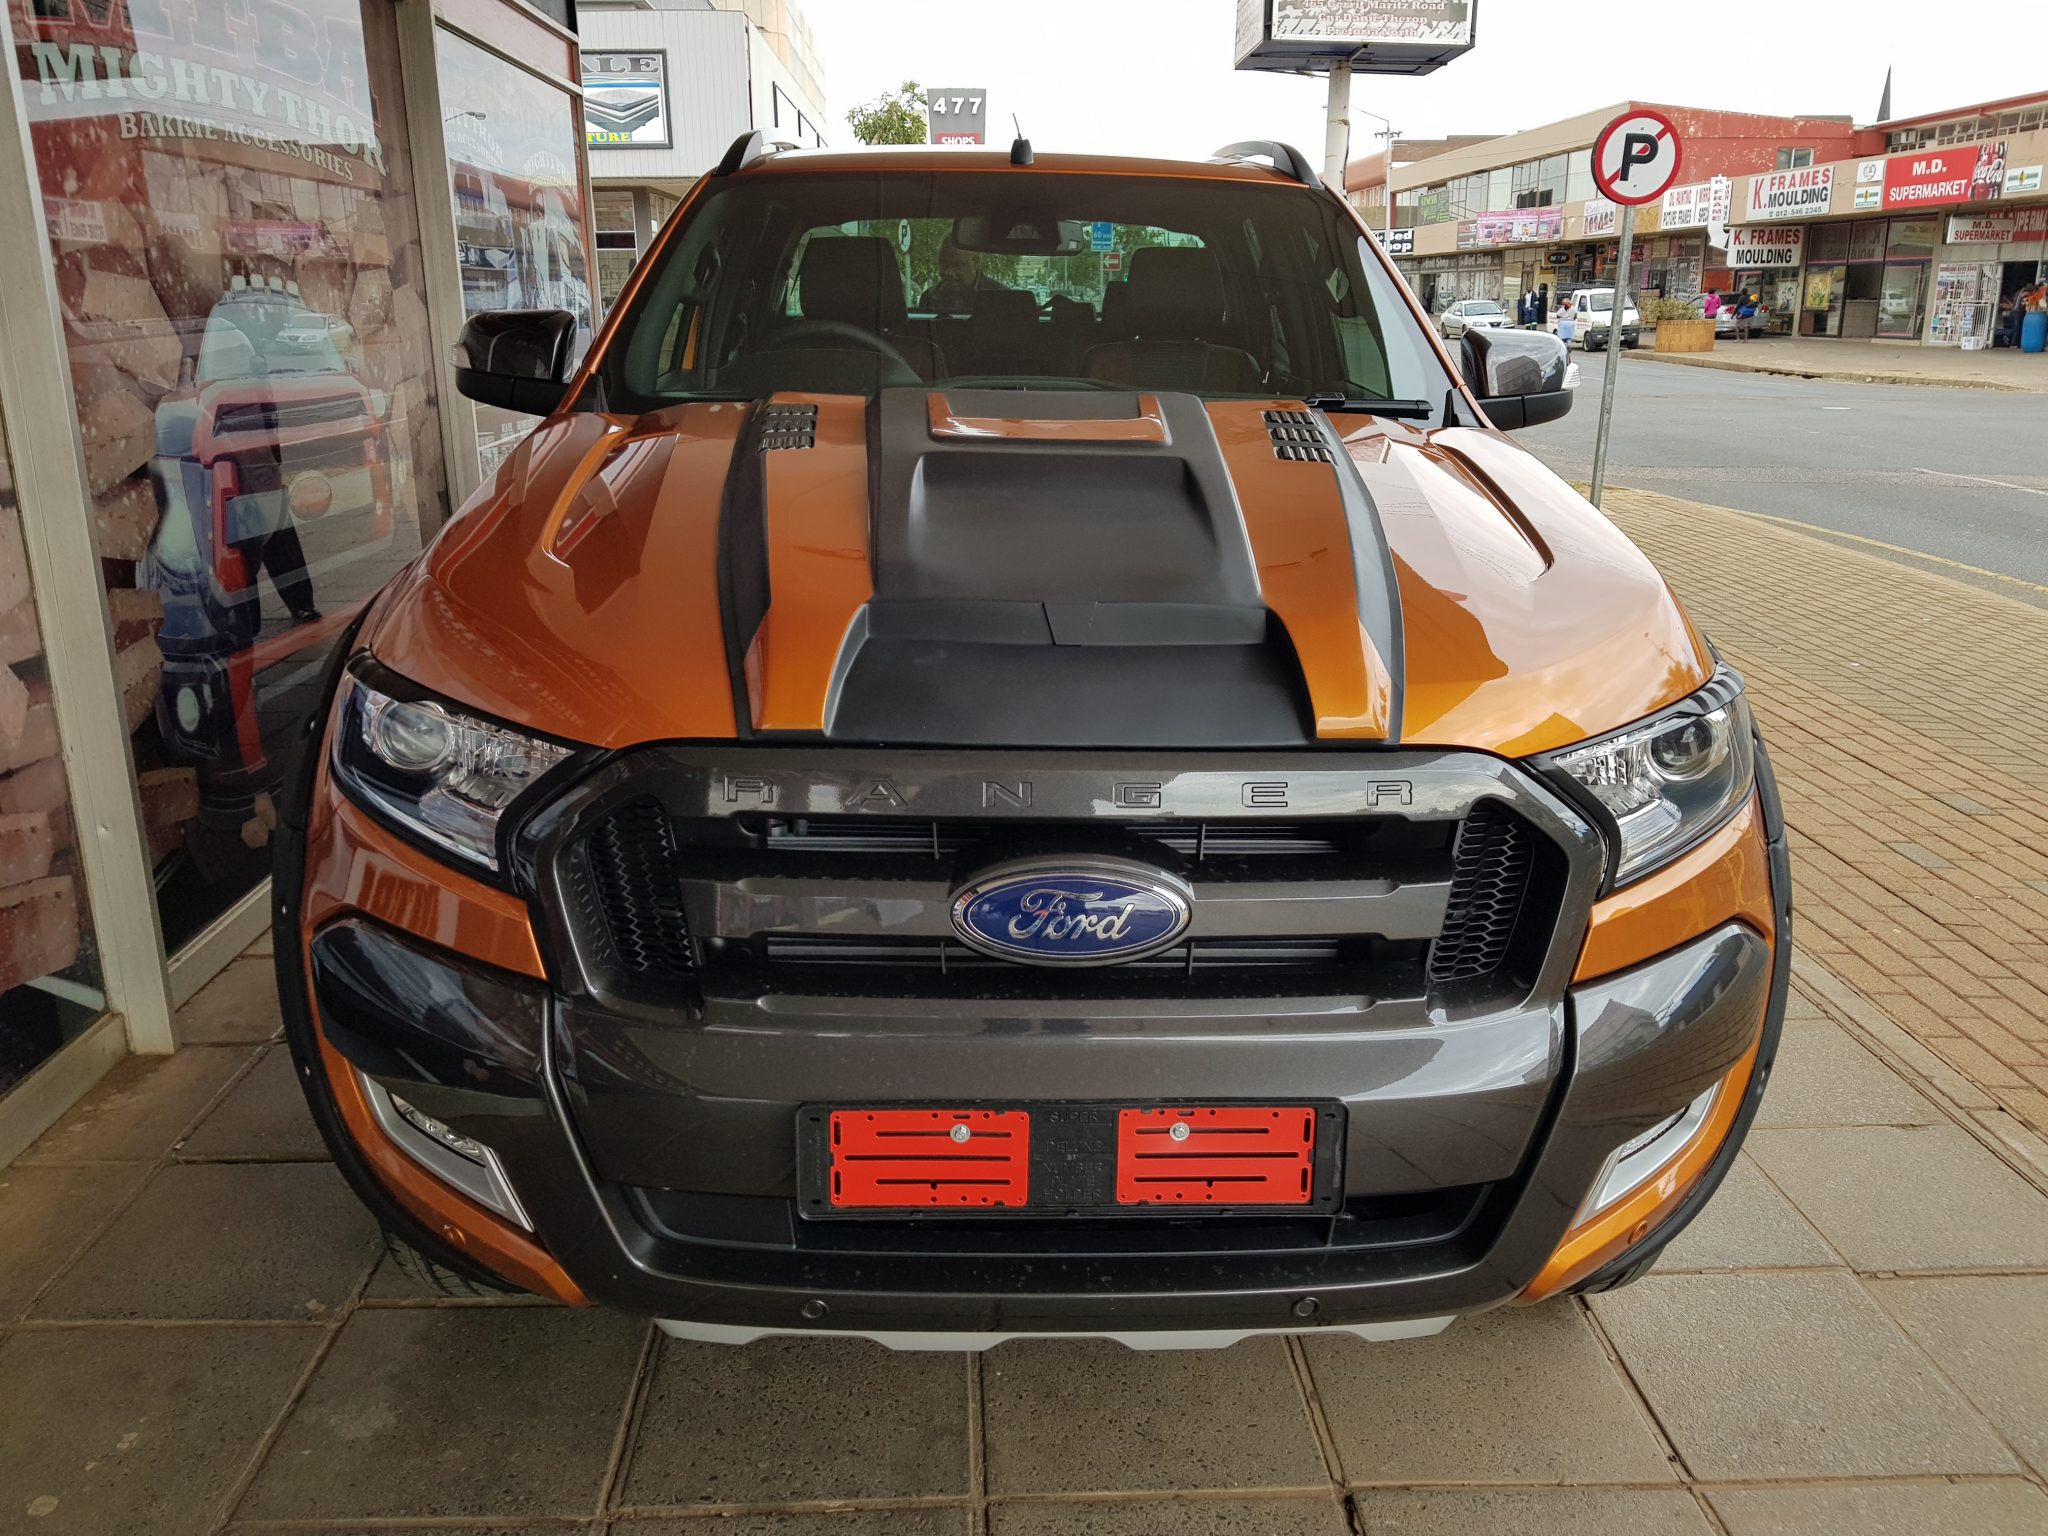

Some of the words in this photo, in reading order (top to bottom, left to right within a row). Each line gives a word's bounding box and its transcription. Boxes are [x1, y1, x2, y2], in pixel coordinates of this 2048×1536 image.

[1367, 1, 1408, 10] Maritz
[1411, 1, 1445, 10] Road
[1382, 15, 1428, 23] Theron
[1326, 26, 1379, 36] Pretoria
[1381, 27, 1418, 37] North
[31, 42, 269, 118] MIGHTY
[277, 88, 389, 176] THOR
[932, 96, 982, 115] 477
[118, 112, 218, 141] BAKKIE
[224, 121, 354, 181] ACCESSORIES
[941, 136, 975, 144] SHOPS
[1619, 132, 1659, 182] P
[1912, 159, 1948, 176] M.D.
[1769, 167, 1831, 192] FRAMES
[1768, 186, 1829, 209] MOULDING
[1889, 179, 1968, 202] SUPERMARKET
[1972, 221, 1995, 230] M.D.
[1733, 229, 1745, 246] K.
[1750, 228, 1801, 245] FRAMES
[1954, 230, 2011, 241] SUPERMARKET
[1476, 253, 1492, 266] Shop
[1735, 248, 1793, 265] MOULDING
[722, 775, 1415, 810] RANGER
[1008, 886, 1134, 943] Ford
